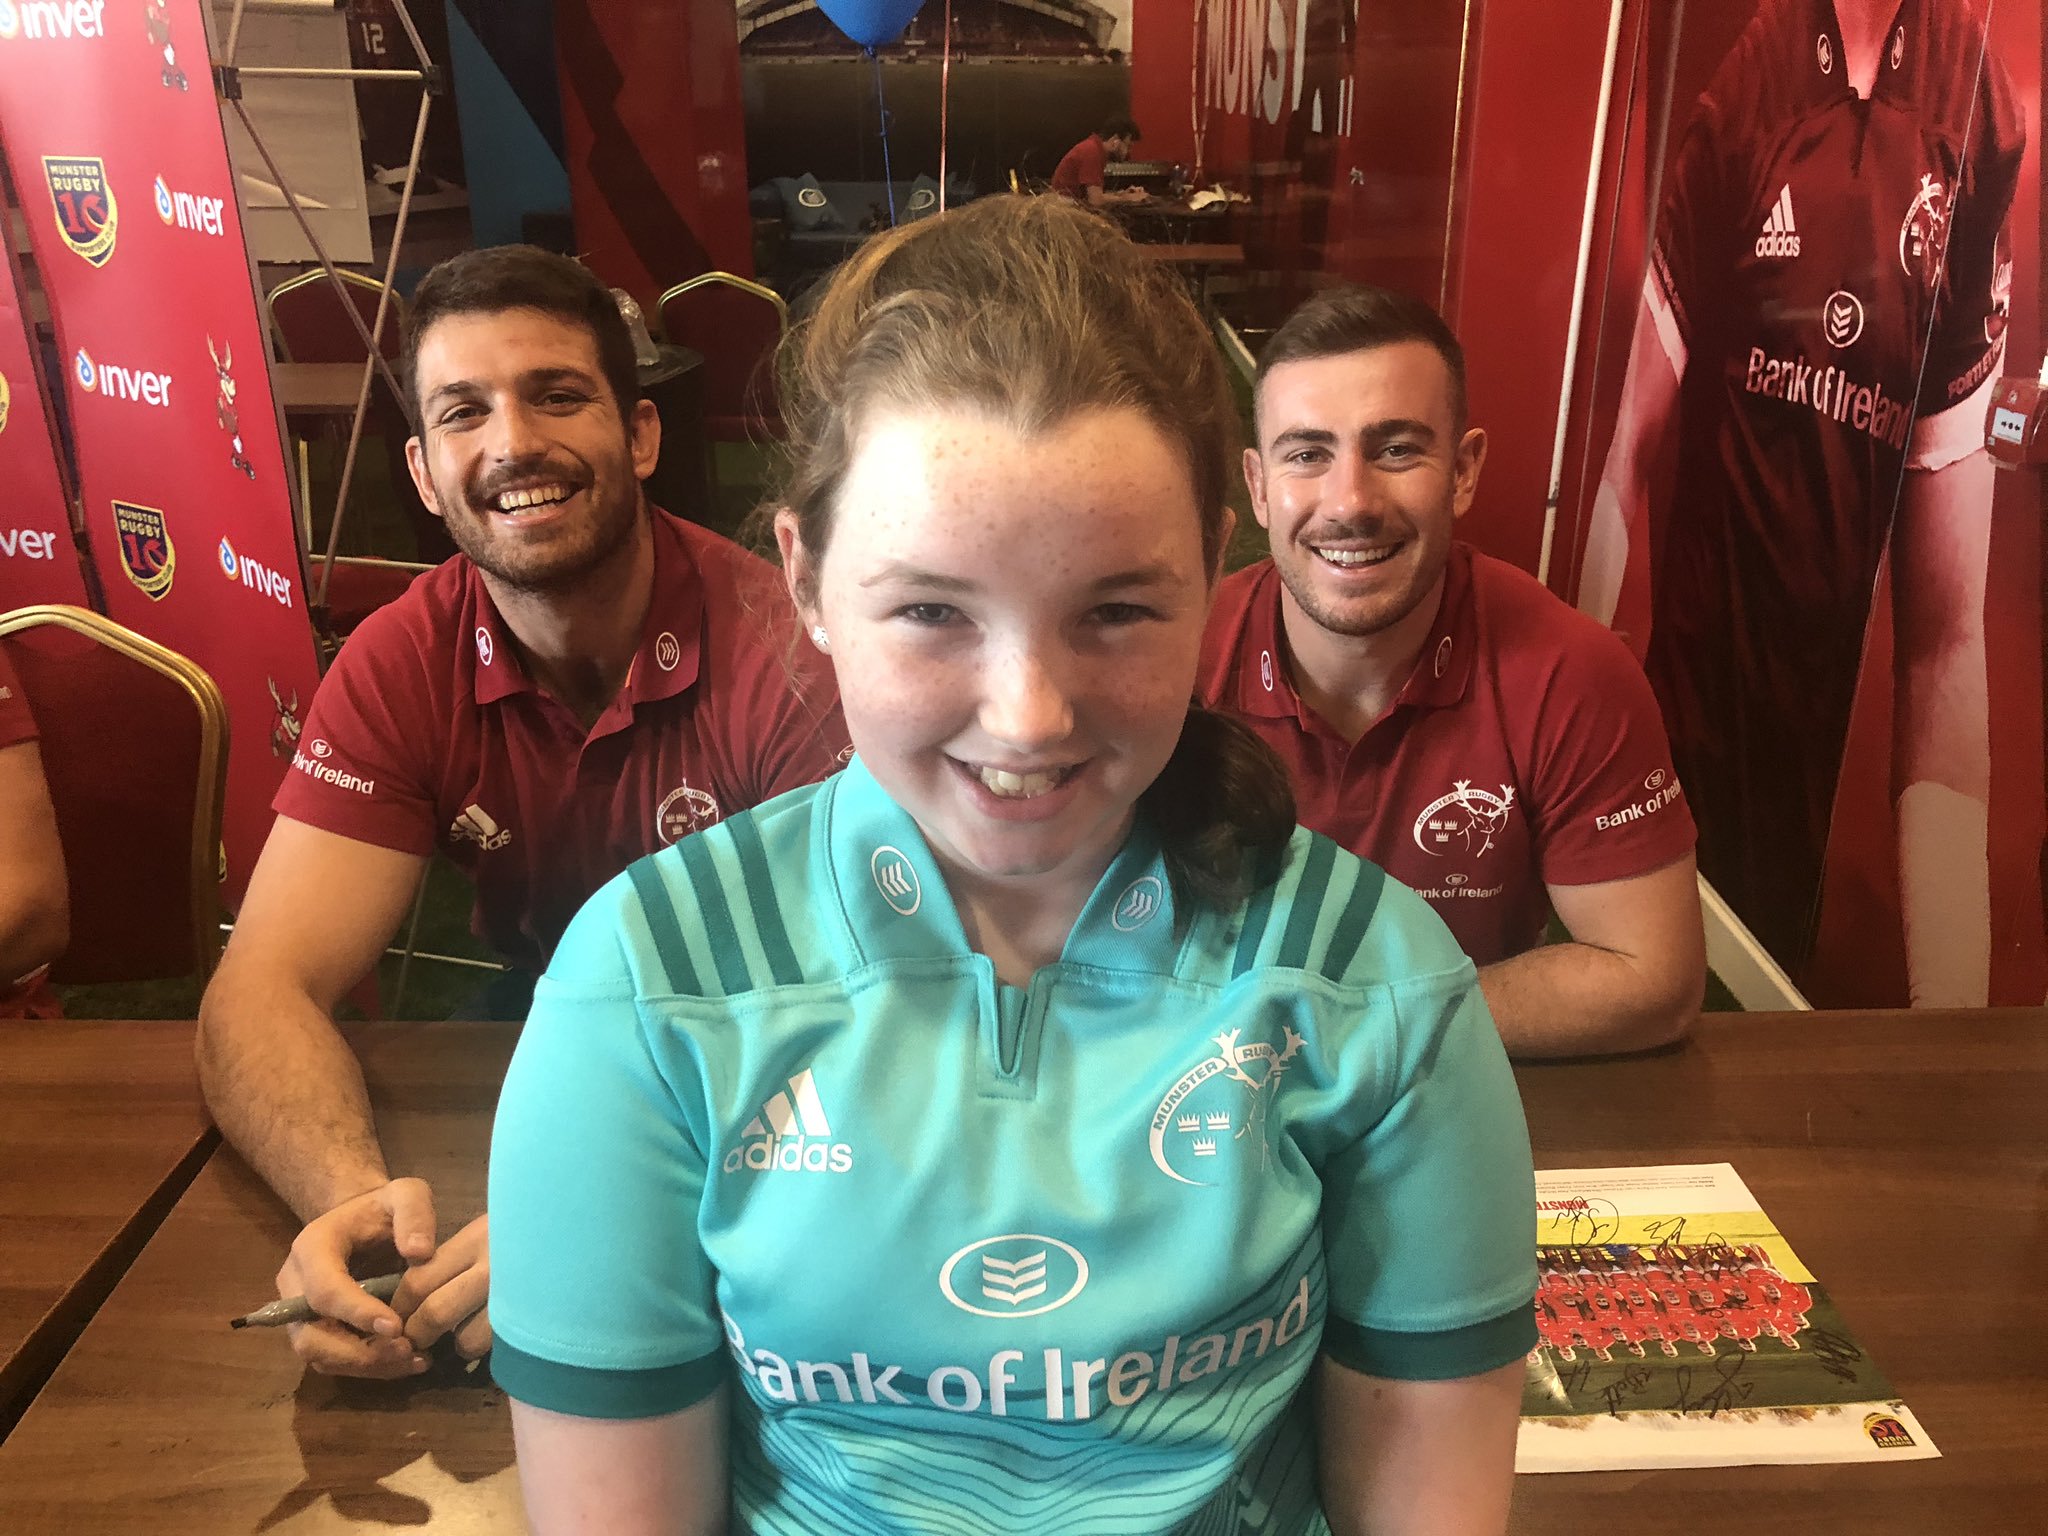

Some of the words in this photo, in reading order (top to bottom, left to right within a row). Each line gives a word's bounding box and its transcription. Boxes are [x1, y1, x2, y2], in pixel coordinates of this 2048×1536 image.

[50, 165, 99, 176] MUNSTER
[53, 177, 101, 192] RUGBY
[174, 191, 224, 236] inver
[1755, 231, 1800, 257] adidas
[99, 363, 172, 407] inver
[1746, 346, 1812, 405] Bank
[1812, 365, 1835, 415] of
[117, 508, 160, 526] MUNSTER
[120, 518, 161, 538] RUGBY
[240, 554, 292, 608] inver
[314, 762, 374, 795] Ireland
[686, 790, 711, 801] UGBY
[1418, 795, 1455, 826] MUNSTER
[1468, 791, 1500, 804] RUGBY
[1595, 803, 1645, 831] Bank
[1645, 792, 1662, 813] of
[1411, 887, 1440, 898] ank
[1442, 887, 1458, 898] of
[1458, 884, 1503, 898] Ireland
[1153, 1061, 1218, 1131] MUNSTER
[724, 1133, 852, 1174] adidas
[722, 1311, 911, 1404] Bank
[926, 1351, 1024, 1417] of
[1044, 1275, 1309, 1420] Ireland
